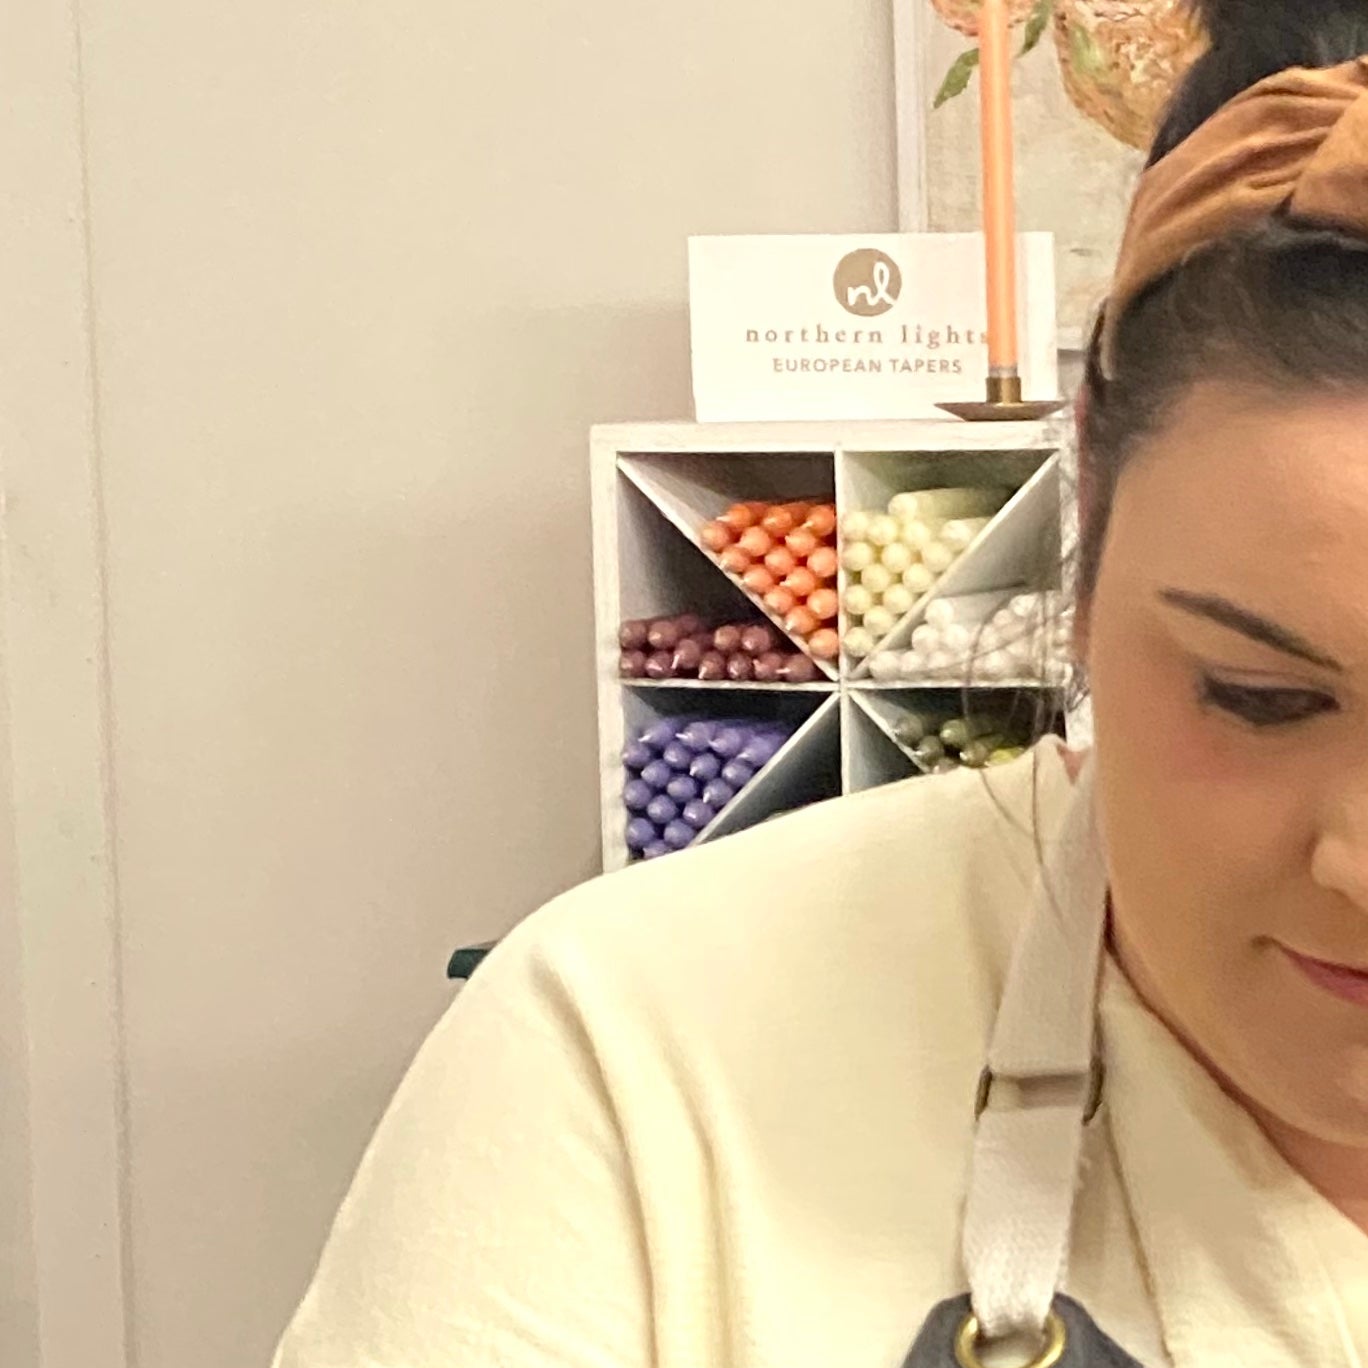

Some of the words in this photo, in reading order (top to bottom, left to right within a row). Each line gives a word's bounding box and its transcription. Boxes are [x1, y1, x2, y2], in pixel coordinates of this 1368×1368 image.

[846, 260, 898, 307] nl
[745, 323, 883, 344] northern
[772, 357, 882, 374] EUROPEAN
[889, 358, 963, 374] TAPERS
